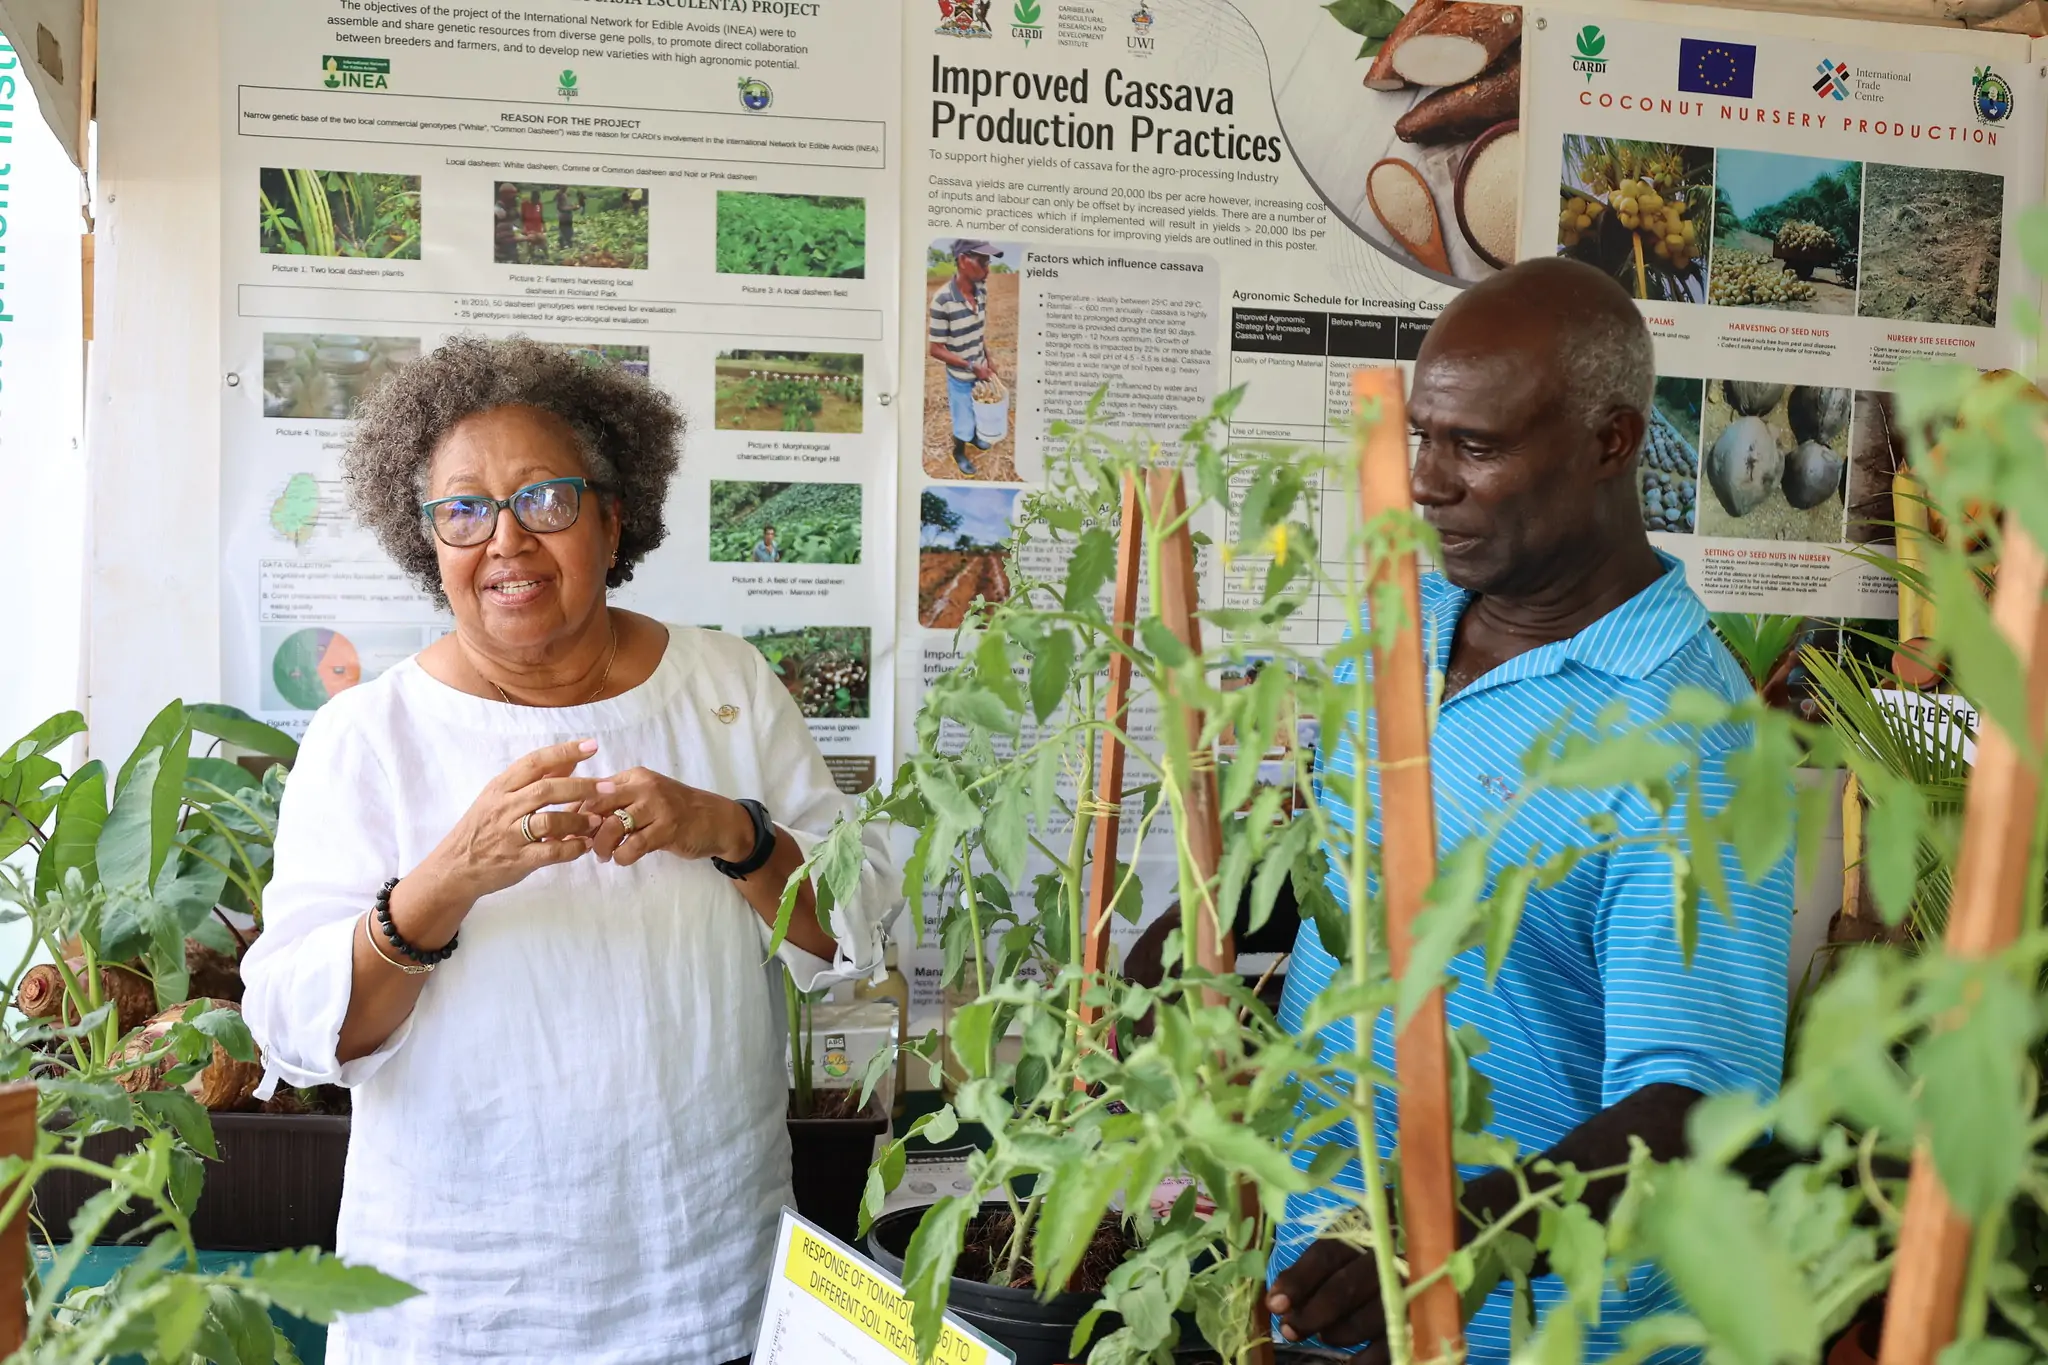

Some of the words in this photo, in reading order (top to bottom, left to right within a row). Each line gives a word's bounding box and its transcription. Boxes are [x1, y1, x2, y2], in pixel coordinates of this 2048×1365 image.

[752, 2, 819, 17] PROJECT
[1058, 4, 1094, 14] CARIBBEAN
[340, 0, 360, 10] The
[364, 2, 416, 13] objectives
[420, 5, 430, 14] of
[433, 6, 449, 16] the
[453, 8, 488, 19] project
[491, 9, 501, 19] of
[504, 10, 520, 20] the
[524, 12, 587, 24] International
[590, 16, 632, 26] Network
[635, 18, 648, 28] for
[652, 20, 682, 30] Edible
[686, 22, 720, 33] Avoids
[723, 25, 756, 36] (INEA)
[786, 29, 796, 37] to
[1058, 14, 1104, 24] AGRICULTURAL
[1012, 27, 1043, 40] CARDI
[1058, 22, 1089, 31] RESEARCH
[1092, 24, 1107, 32] AND
[327, 17, 378, 27] assemble
[381, 20, 401, 28] and
[404, 20, 434, 30] share
[437, 24, 475, 33] genetic
[478, 26, 529, 36] resources
[533, 28, 556, 37] from
[559, 30, 596, 40] diverse
[600, 34, 624, 43] gene
[628, 35, 654, 45] polls,
[657, 37, 667, 45] to
[670, 39, 711, 47] promote
[714, 40, 741, 49] direct
[745, 42, 807, 53] collaboration
[1058, 31, 1104, 41] DEVELOPMENT
[336, 32, 380, 43] between
[384, 35, 431, 46] breeders
[434, 39, 453, 48] and
[457, 39, 499, 51] farmers,
[503, 44, 522, 52] and
[526, 45, 535, 53] to
[538, 45, 579, 57] develop
[606, 51, 648, 60] varieties
[652, 52, 672, 61] with
[675, 53, 696, 64] high
[700, 56, 751, 66] agronomic
[755, 60, 798, 68] potential.
[1058, 39, 1089, 48] INSTITUTE
[1126, 36, 1155, 50] UWI
[1572, 60, 1606, 74] CARDI
[342, 73, 388, 90] INEA
[1856, 68, 1911, 82] International
[933, 54, 1088, 107] Improved
[1105, 68, 1233, 115] Cassava
[1856, 79, 1880, 90] Trade
[1855, 91, 1884, 103] Centre
[501, 113, 544, 123] REASON
[547, 116, 568, 124] FOR
[571, 117, 590, 125] THE
[594, 118, 640, 128] PROJECT
[1579, 91, 1704, 116] COCONUT
[1721, 106, 1826, 129] NURSERY
[1844, 118, 1998, 147] PRODUCTION
[932, 100, 1114, 151] Production
[1131, 115, 1281, 163] Practices
[929, 149, 942, 159] To
[945, 152, 986, 163] support
[990, 153, 1024, 166] higher
[1027, 157, 1057, 167] yields
[1060, 158, 1070, 168] of
[1073, 161, 1112, 171] cassava
[1116, 161, 1129, 172] for
[1132, 163, 1149, 173] the
[1152, 167, 1234, 182] agro-processing
[1237, 171, 1278, 185] Industry
[928, 175, 972, 186] Cassava
[976, 180, 1004, 189] yields
[1008, 182, 1024, 190] are
[1027, 184, 1069, 195] currently
[1073, 187, 1108, 196] around
[1111, 187, 1144, 198] 20,000
[1148, 190, 1162, 199] lbs
[1166, 193, 1181, 202] per
[1184, 194, 1206, 202] acre
[1208, 194, 1250, 206] however,
[1254, 199, 1302, 211] increasing
[1306, 200, 1327, 210] cost
[272, 264, 298, 272] Picture
[1027, 252, 1068, 263] Factors
[1072, 256, 1104, 265] which
[1108, 258, 1156, 269] influence
[1160, 263, 1203, 272] cassava
[1027, 267, 1058, 278] yields
[1232, 290, 1290, 301] Agronomic
[1294, 293, 1341, 304] Schedule
[1344, 296, 1358, 305] for
[1362, 298, 1415, 311] Increasing
[1236, 313, 1267, 321] Improved
[1269, 315, 1305, 323] Agronomic
[1331, 318, 1354, 327] Before
[1355, 320, 1382, 329] Planting
[1649, 317, 1675, 326] PALMS
[1236, 322, 1264, 332] Strategy
[1276, 324, 1310, 334] Increasing
[1729, 323, 1776, 332] HARVESTING
[1778, 326, 1788, 334] OF
[1811, 329, 1828, 337] NUTS
[1235, 332, 1264, 340] Cassava
[1266, 333, 1282, 341] Yield
[1887, 334, 1917, 342] NURSERY
[1936, 338, 1974, 347] SELECTION
[1234, 356, 1257, 364] Quality
[1260, 358, 1266, 366] of
[1268, 359, 1295, 369] Planting
[803, 1237, 850, 1280] RESPONSE
[851, 1269, 865, 1290] OF
[956, 1338, 970, 1362] TO
[810, 1272, 859, 1318] DIFFERENT
[860, 1304, 880, 1335] SOIL
